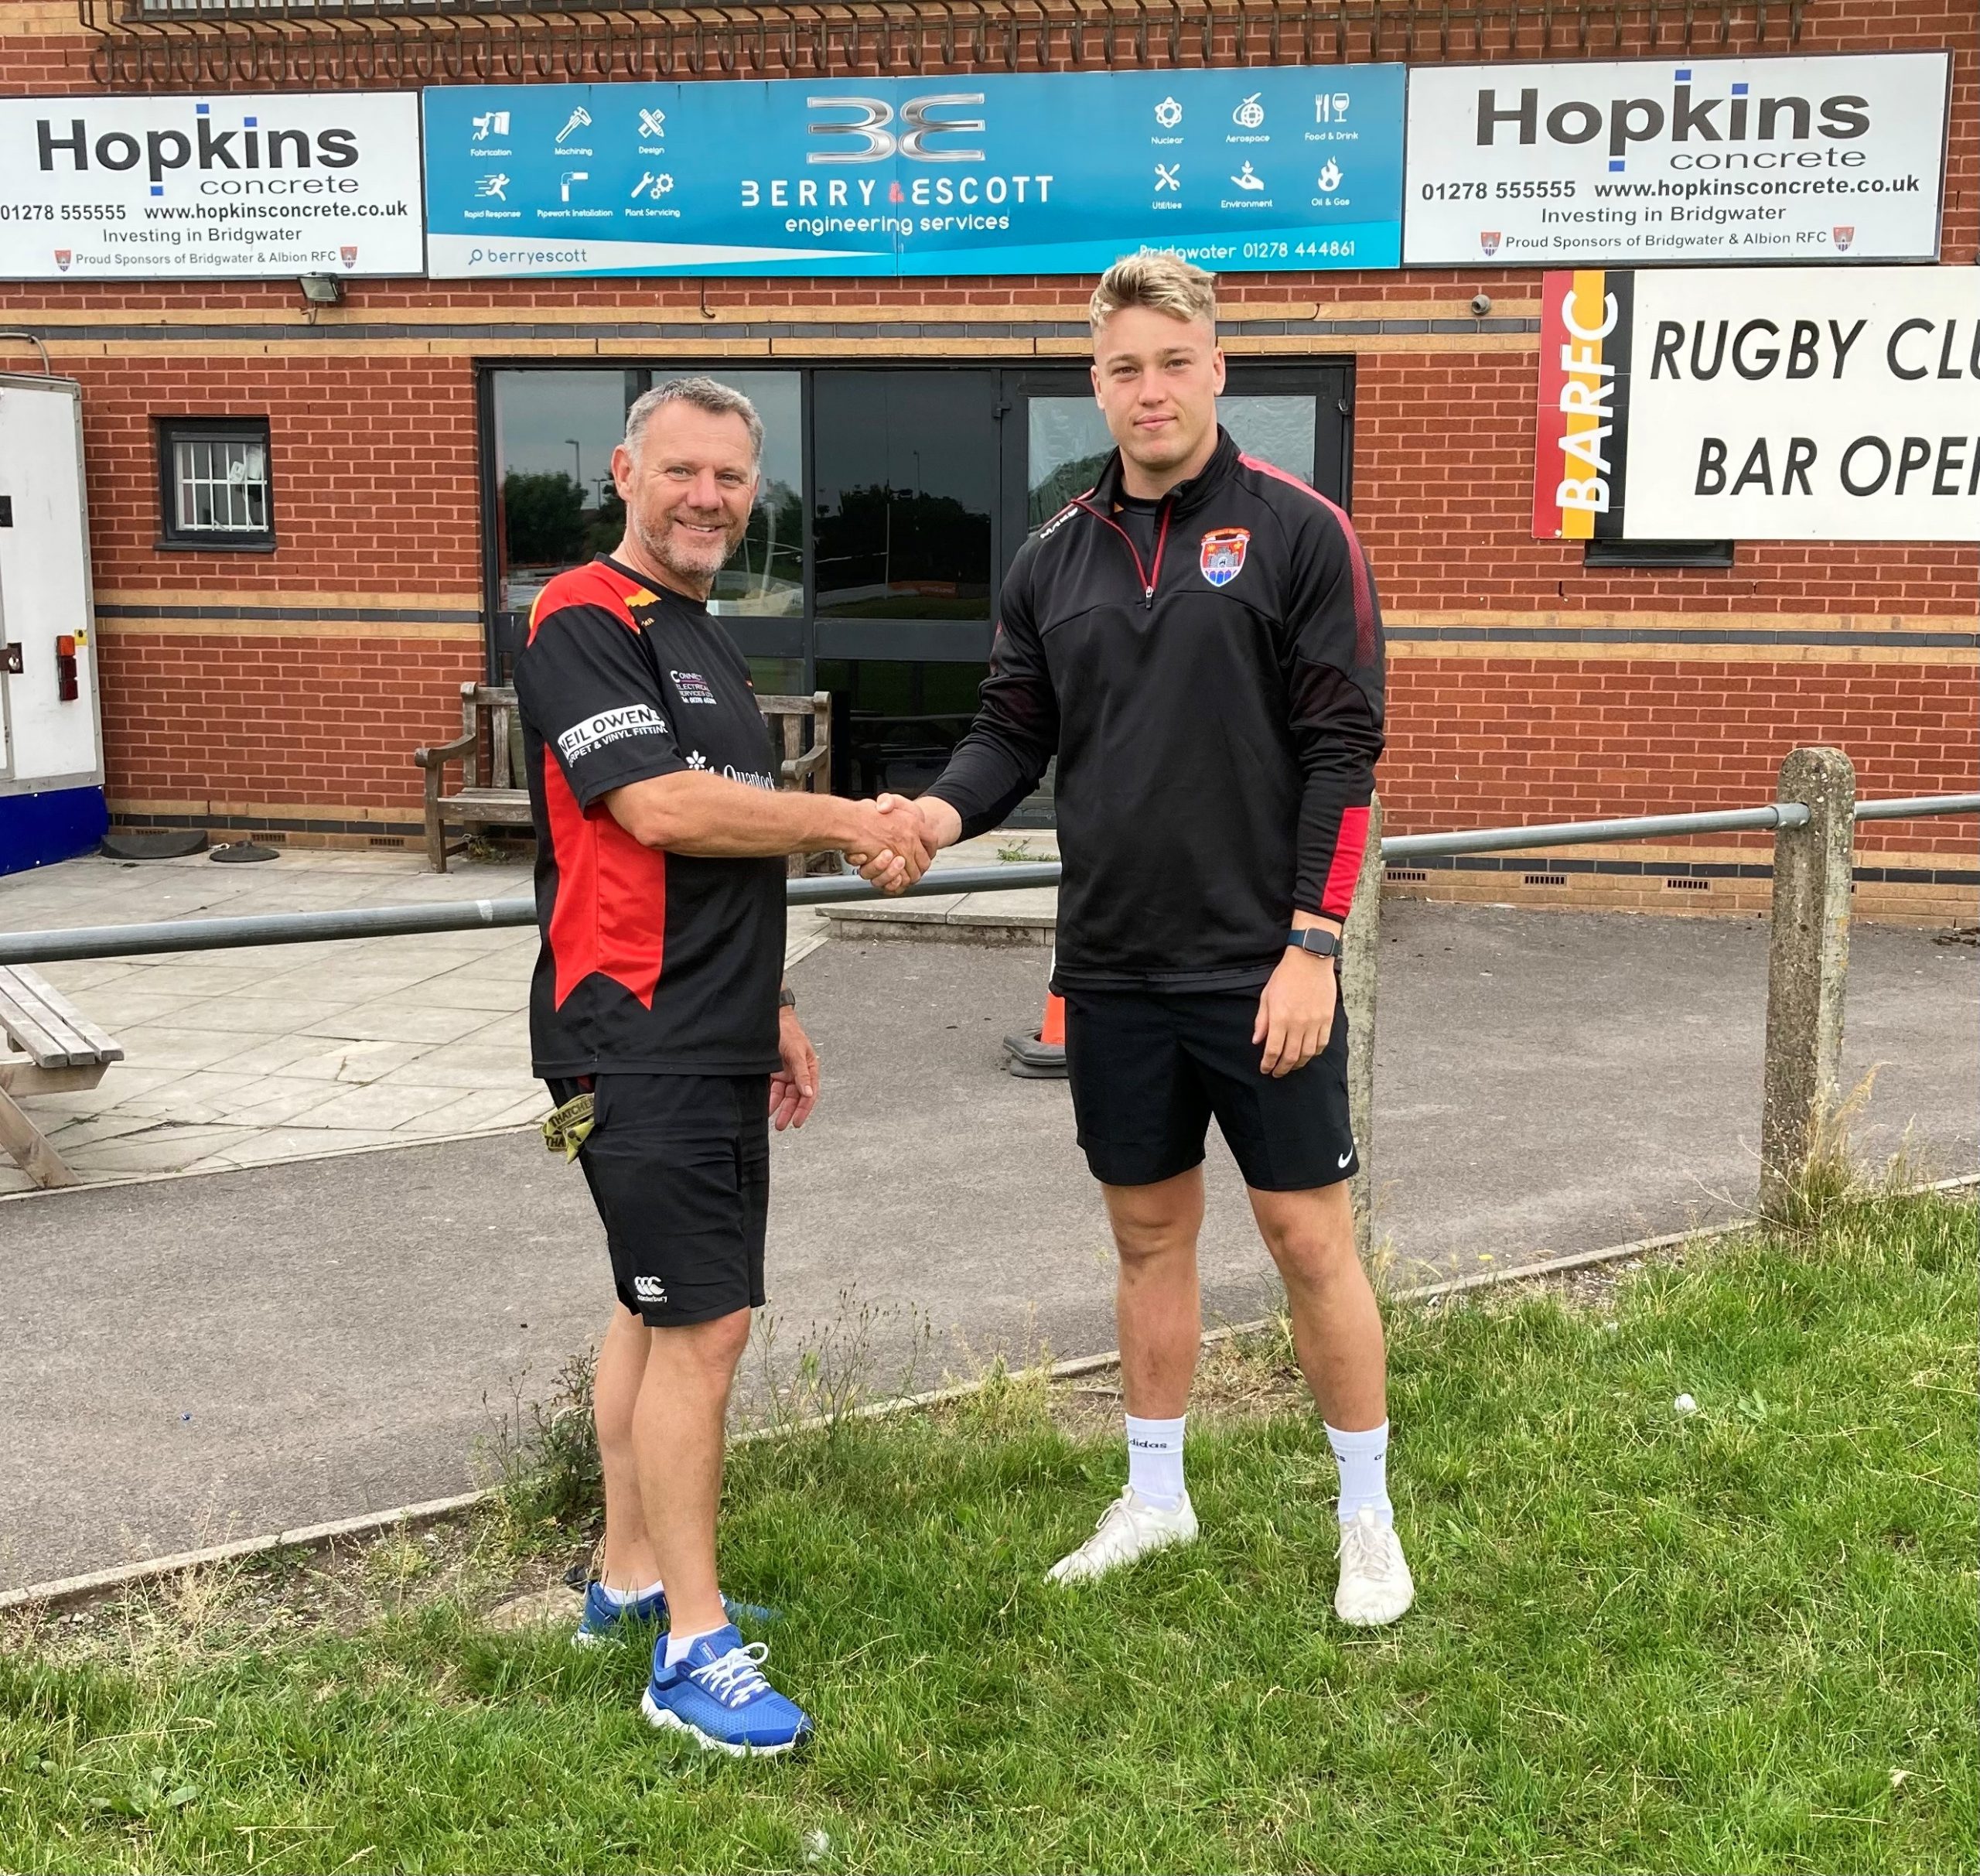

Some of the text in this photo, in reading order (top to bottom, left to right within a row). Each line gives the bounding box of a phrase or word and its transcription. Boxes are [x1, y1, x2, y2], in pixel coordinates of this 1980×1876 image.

[1476, 69, 1870, 173] Hopkins
[1151, 136, 1184, 145] Nuclear
[1225, 135, 1270, 144] Aerospace
[1304, 132, 1359, 141] Food & Drink
[36, 103, 359, 196] Hopkins
[555, 147, 593, 156] Machining
[638, 145, 665, 155] Design
[1670, 147, 1866, 170] concrete
[200, 175, 359, 195] concrete
[741, 175, 1053, 207] BERRY & ESCOTT
[1422, 174, 1920, 201] 01278 555555 www.hopkinsconcrete.co.uk
[0, 200, 408, 220] 01278 555555 www.hopkinsconcrete.co.uk
[1152, 201, 1183, 210] Utilities
[1220, 199, 1273, 208] Environment
[1311, 197, 1350, 207] Oil & Gas
[464, 210, 521, 219] Rapid Response
[537, 209, 613, 219] Pipework Installation
[625, 208, 681, 218] Plant Servicing
[1541, 205, 1787, 226] Investing in Bridgwater
[785, 214, 1009, 237] engineering services
[103, 227, 302, 245] Investing in Bridgwater
[1506, 231, 1827, 251] Proud Sponsors of Bridgwater & Albion RFC
[488, 248, 587, 265] berryescott
[1242, 241, 1289, 258] 01278
[1294, 240, 1355, 258] 444861
[76, 251, 336, 267] Proud Sponsors of Bridgwater & Albion RFC
[1650, 317, 1980, 381] RUGBY CL
[1556, 290, 1619, 514] BARFC
[1694, 437, 1818, 496] BAR
[559, 729, 592, 753] NEIL
[593, 740, 602, 750] &
[602, 730, 633, 746] VINYL
[1128, 1438, 1167, 1448] didas
